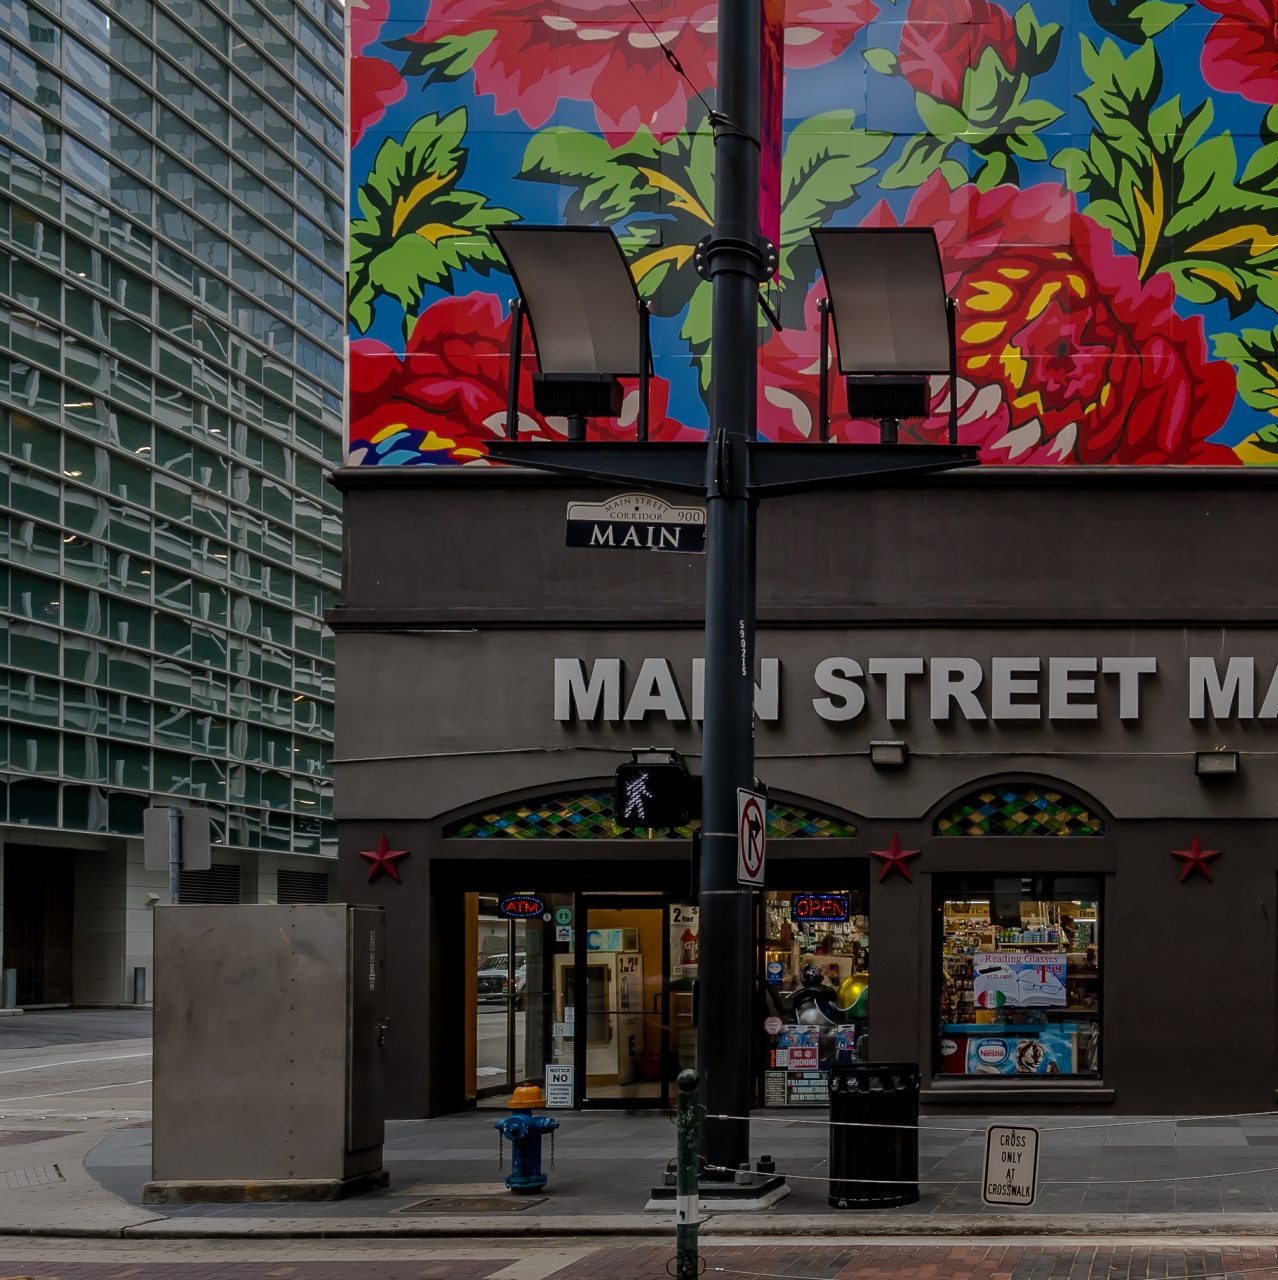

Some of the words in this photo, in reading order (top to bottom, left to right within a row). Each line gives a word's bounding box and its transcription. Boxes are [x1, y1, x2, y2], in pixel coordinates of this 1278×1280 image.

[605, 498, 631, 512] MAIN
[635, 497, 669, 513] STREET
[610, 511, 663, 520] CORRIDOR
[678, 511, 700, 522] 900
[589, 523, 682, 548] MAIN
[812, 656, 1157, 721] STREET
[505, 901, 539, 913] ATM
[797, 900, 845, 916] OPEN
[673, 907, 682, 923] 2
[985, 954, 1022, 965] Reading
[1024, 954, 1058, 963] Glasses
[793, 1050, 803, 1058] NO
[790, 1058, 817, 1066] SMOKING
[552, 1074, 568, 1082] NO
[1000, 1134, 1026, 1148] CROSS
[1001, 1151, 1023, 1163] ONLY
[1006, 1168, 1016, 1180] AT
[988, 1183, 1031, 1197] CROSSWALK
